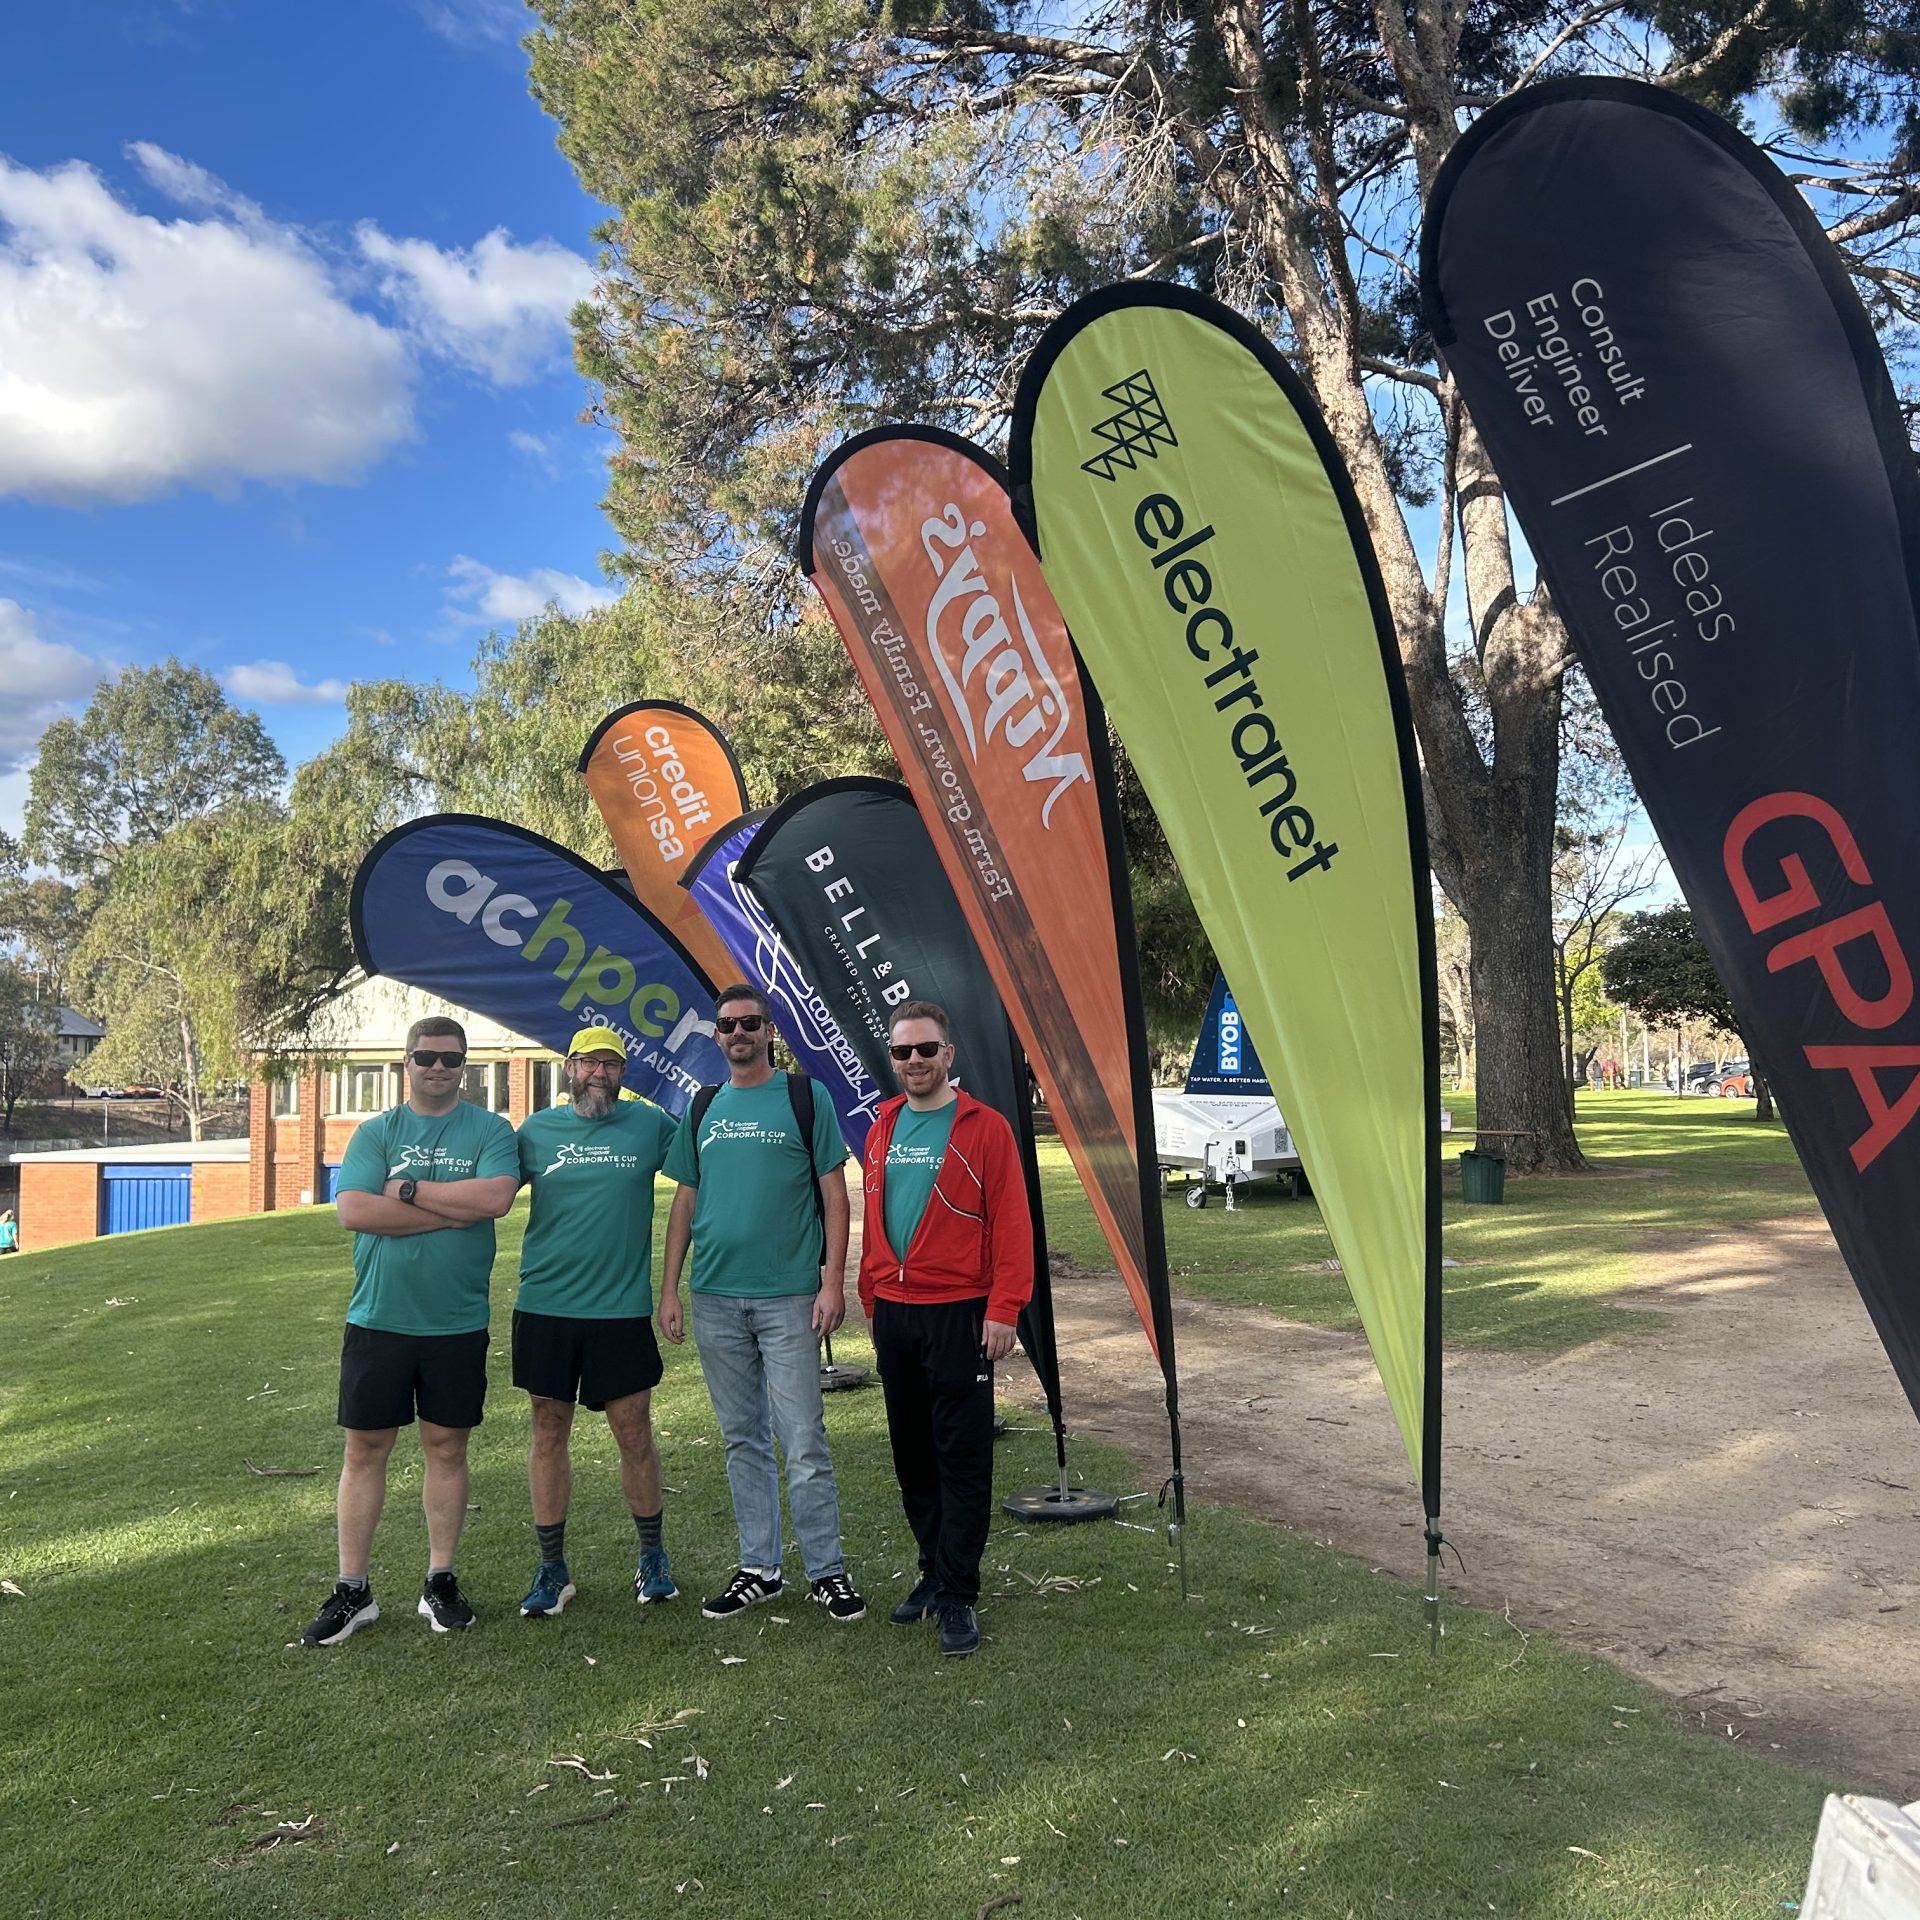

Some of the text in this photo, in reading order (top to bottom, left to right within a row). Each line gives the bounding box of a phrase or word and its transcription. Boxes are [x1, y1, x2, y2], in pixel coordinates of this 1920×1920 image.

[1483, 310, 1554, 427] Deliver
[1525, 293, 1608, 437] Engineer
[1570, 277, 1647, 406] Consult
[1649, 497, 1736, 643] Ideas
[1134, 493, 1339, 883] electranet
[1584, 525, 1722, 750] Realised
[612, 735, 685, 863] unionsa
[644, 726, 712, 831] credit
[425, 858, 715, 1054] achper
[823, 926, 858, 977] CRAFTED
[871, 1008, 892, 1047] GENER
[846, 985, 881, 1038] EST. 1920
[1723, 791, 1920, 1175] GPA
[642, 1050, 702, 1098] AUSTR
[1220, 1011, 1239, 1071] BYOB
[411, 1157, 473, 1167] CORRATE CUP
[566, 1155, 619, 1164] CORPORATE
[716, 1131, 786, 1139] CORPORATE CUP
[889, 1156, 935, 1164] CORPORATE
